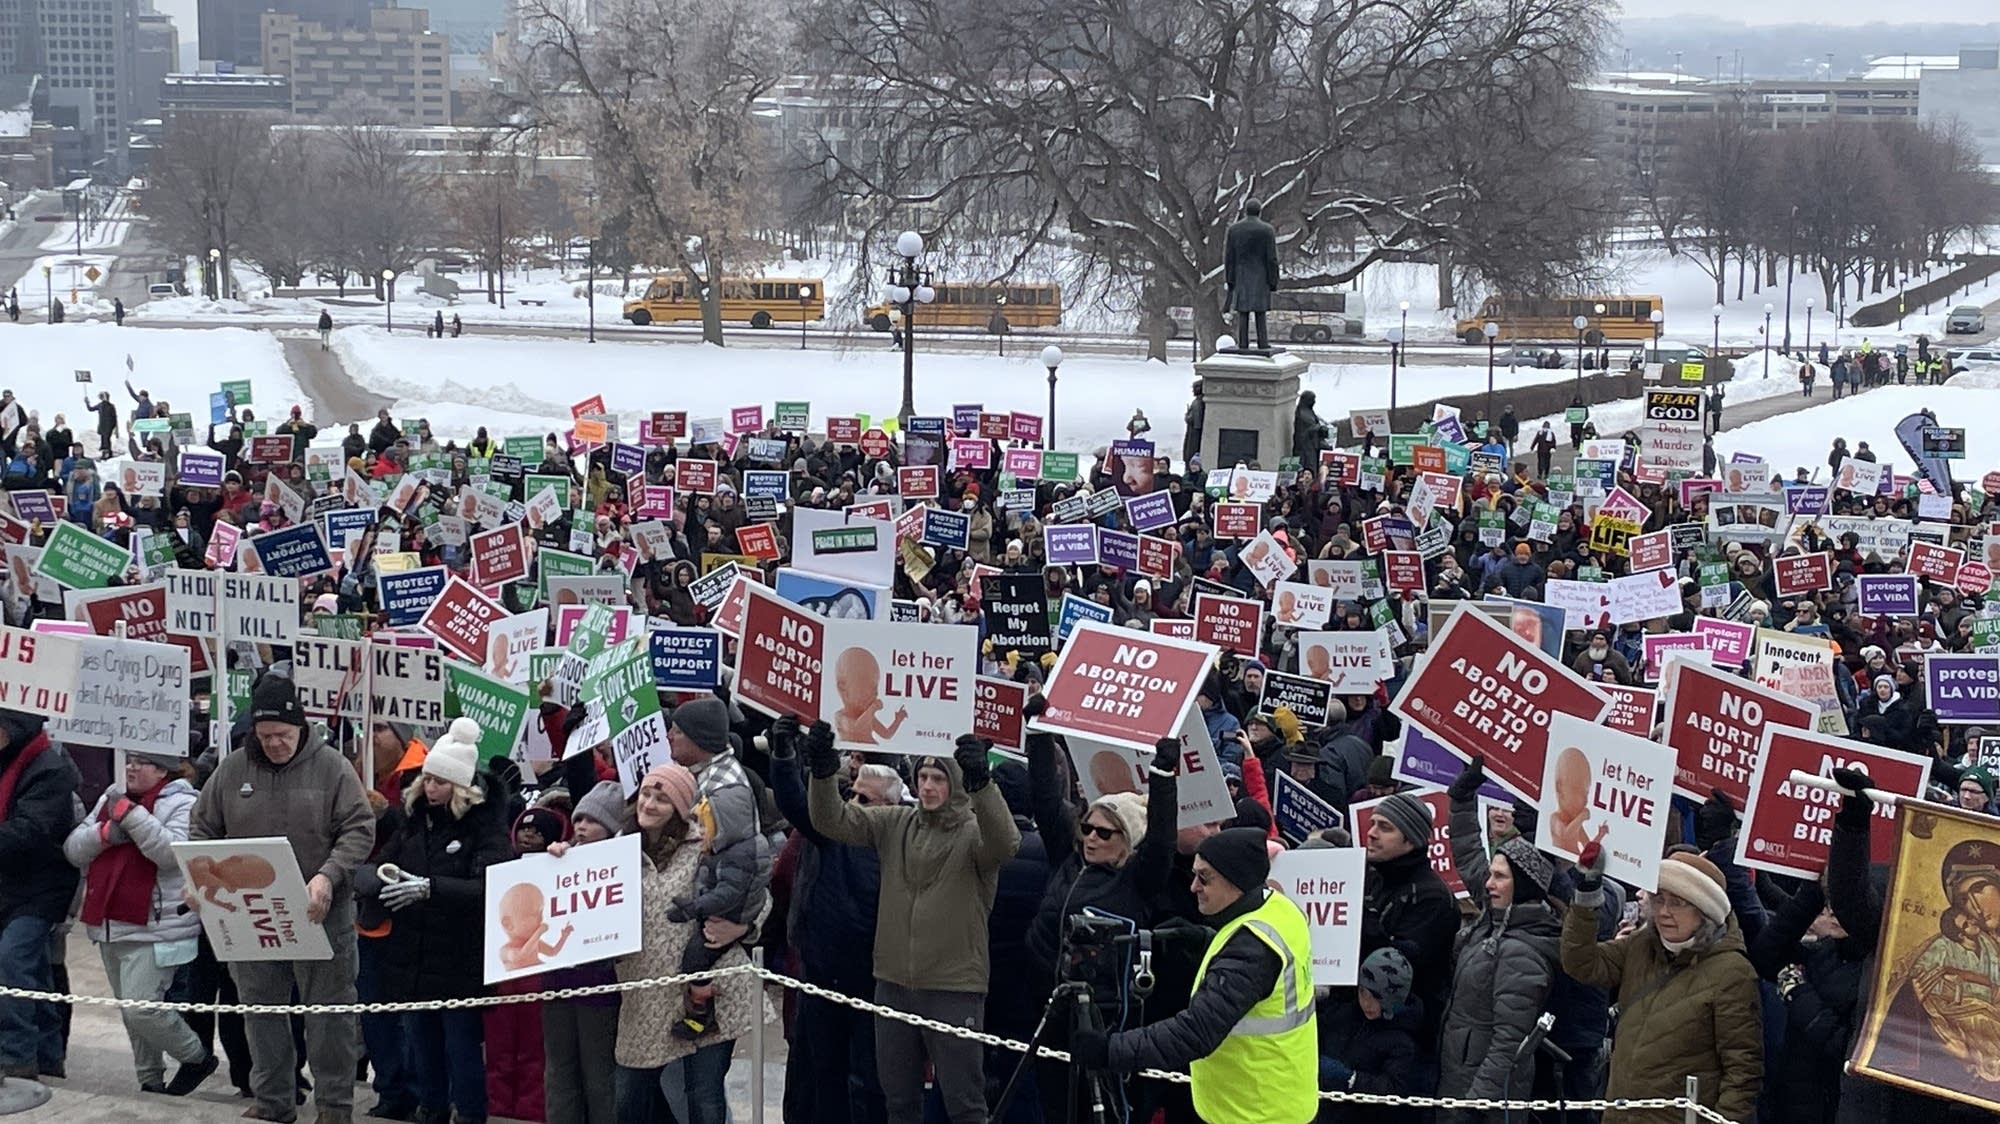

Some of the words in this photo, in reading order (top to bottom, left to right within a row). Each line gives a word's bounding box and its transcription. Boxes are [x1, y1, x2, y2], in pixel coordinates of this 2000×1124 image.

[1651, 394, 1696, 405] FEAR
[1650, 407, 1696, 419] GOD
[737, 415, 758, 425] LIFE
[1014, 424, 1038, 435] LIFE
[1658, 423, 1688, 433] Don't
[1653, 440, 1693, 450] Murder
[958, 450, 985, 460] LIFE
[1114, 447, 1151, 457] HUMAN!
[1010, 460, 1035, 469] LIFE
[1418, 458, 1441, 466] LIFE
[1655, 456, 1690, 467] Babies
[185, 466, 198, 474] LA
[200, 466, 217, 475] VIDA
[1744, 474, 1765, 482] LIVE
[1249, 481, 1270, 489] LIVE
[1136, 512, 1145, 520] LA
[1148, 507, 1168, 517] VIDA
[1232, 507, 1244, 515] NO
[332, 515, 372, 523] PROTECT
[930, 514, 965, 525] PROTECT
[928, 525, 964, 537] SUPPORT
[1828, 520, 1869, 533] Knights
[488, 534, 504, 548] NO
[1052, 531, 1089, 541] protege
[60, 533, 78, 546] ALL
[81, 542, 121, 568] HUMANS
[266, 541, 317, 560] SUPPORT
[481, 542, 516, 561] ABORTION
[746, 539, 770, 551] LIFE
[1053, 542, 1065, 551] LA
[1068, 542, 1090, 551] VIDA
[1149, 541, 1161, 551] NO
[55, 543, 80, 560] HAVE
[82, 554, 115, 576] HUMAN
[489, 557, 500, 566] UP
[500, 553, 509, 562] TO
[1928, 549, 1946, 558] NO
[489, 561, 512, 573] BIRTH
[1397, 556, 1410, 565] NO
[1793, 560, 1809, 568] NO
[1917, 555, 1955, 569] ABORTION
[63, 559, 96, 581] RIGHTS
[1264, 559, 1284, 581] LIVE
[1782, 567, 1822, 579] ABORTION
[1964, 569, 1987, 577] STOP
[387, 576, 439, 590] PROTECT
[1330, 575, 1356, 584] LIVE
[226, 580, 294, 603] SHALL
[1011, 585, 1016, 596] I
[1866, 582, 1909, 592] protege
[1963, 583, 1982, 593] NOW
[389, 596, 438, 609] SUPPORT
[1883, 593, 1909, 601] VIDA
[121, 599, 154, 621] NO
[468, 598, 491, 618] NO
[993, 602, 1040, 614] Regret
[1067, 602, 1105, 620] PROTECT
[1219, 604, 1239, 616] NO
[1296, 600, 1325, 612] LIVE
[176, 611, 216, 631] NOT
[240, 617, 287, 639] KILL
[454, 614, 469, 629] UP
[464, 623, 480, 637] TO
[1008, 618, 1028, 631] My
[1204, 616, 1252, 628] ABORTION
[446, 621, 478, 645] BIRTH
[780, 616, 814, 648] NO
[1172, 625, 1190, 635] NO
[1214, 624, 1227, 633] UP
[1229, 626, 1240, 635] TO
[1703, 627, 1742, 638] protect
[655, 636, 712, 647] PROTECT
[991, 634, 1048, 646] Abortion
[1212, 632, 1241, 643] BIRTH
[509, 637, 538, 654] LIVE
[1335, 644, 1349, 654] let
[1352, 645, 1368, 654] her
[1655, 642, 1694, 652] protect
[1708, 638, 1741, 652] LIFE
[892, 650, 918, 666] let
[922, 652, 954, 669] her
[1113, 644, 1158, 670] NO
[1765, 642, 1821, 664] Innocent
[654, 657, 712, 669] SUPPORT
[1333, 656, 1371, 668] LIVE
[104, 650, 141, 683] Crying
[145, 655, 182, 688] Dying
[772, 658, 790, 673] UP
[796, 666, 812, 685] TO
[1496, 652, 1549, 696] NO
[1939, 669, 1997, 682] proteg
[232, 674, 250, 697] LIFE
[602, 669, 626, 706] LOVE
[628, 657, 652, 692] LIFE
[1073, 664, 1177, 695] ABORTION
[766, 670, 812, 704] BIRTH
[885, 674, 958, 701] LIVE
[974, 684, 997, 700] NO
[1092, 682, 1119, 697] UP
[1123, 687, 1145, 702] TO
[1451, 657, 1551, 728] ABORTIO
[1941, 687, 1961, 699] LA
[1966, 687, 1998, 699] VID
[457, 683, 517, 718] HUMANS
[1278, 690, 1312, 703] ANTI-
[1612, 691, 1633, 702] NO
[1081, 696, 1142, 718] BIRTH
[1263, 696, 1325, 717] ABORTION
[1468, 688, 1498, 717] UP
[1504, 709, 1529, 734] TO
[1720, 691, 1764, 726] NO
[461, 703, 511, 735] HUMAN
[1452, 701, 1524, 753] BIRTH
[1687, 711, 1759, 749] ABORTI
[578, 724, 600, 750] LIFE
[617, 718, 660, 763] CHOOSE
[1708, 740, 1732, 757] UP
[1738, 745, 1757, 766] TO
[1603, 759, 1624, 781] let
[1627, 766, 1653, 790] her
[1284, 784, 1334, 824] PROTECT
[1593, 782, 1654, 827] LIVE
[1802, 805, 1831, 823] UP
[556, 872, 580, 890] let
[586, 864, 618, 883] her
[1296, 879, 1314, 895] let
[1319, 880, 1345, 895] her
[551, 883, 624, 918] LIVE
[271, 898, 289, 917] let
[243, 894, 282, 949] LIVE
[279, 920, 297, 944] her
